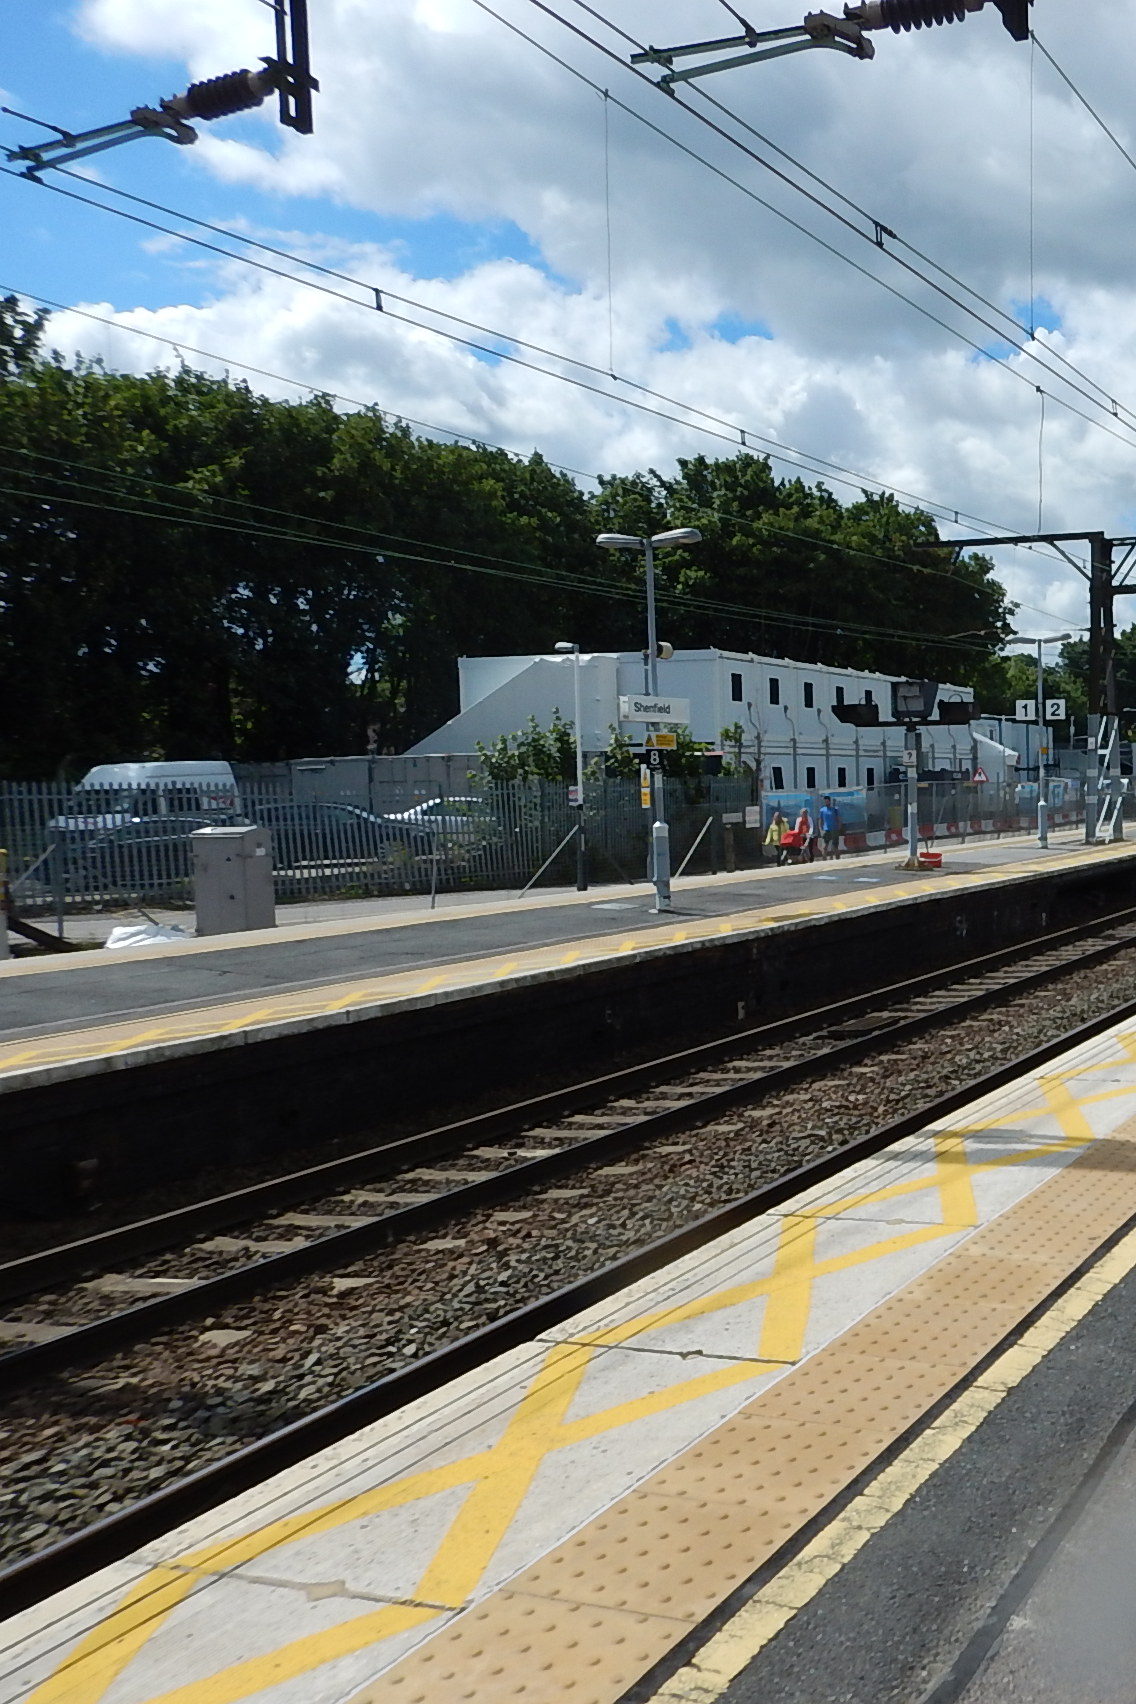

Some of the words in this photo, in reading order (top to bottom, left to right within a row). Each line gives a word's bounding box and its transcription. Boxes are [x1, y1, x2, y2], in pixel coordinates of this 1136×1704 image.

[634, 702, 671, 714] Shenfield
[1022, 703, 1028, 717] 1
[1051, 703, 1060, 716] 2
[650, 751, 660, 764] 8
